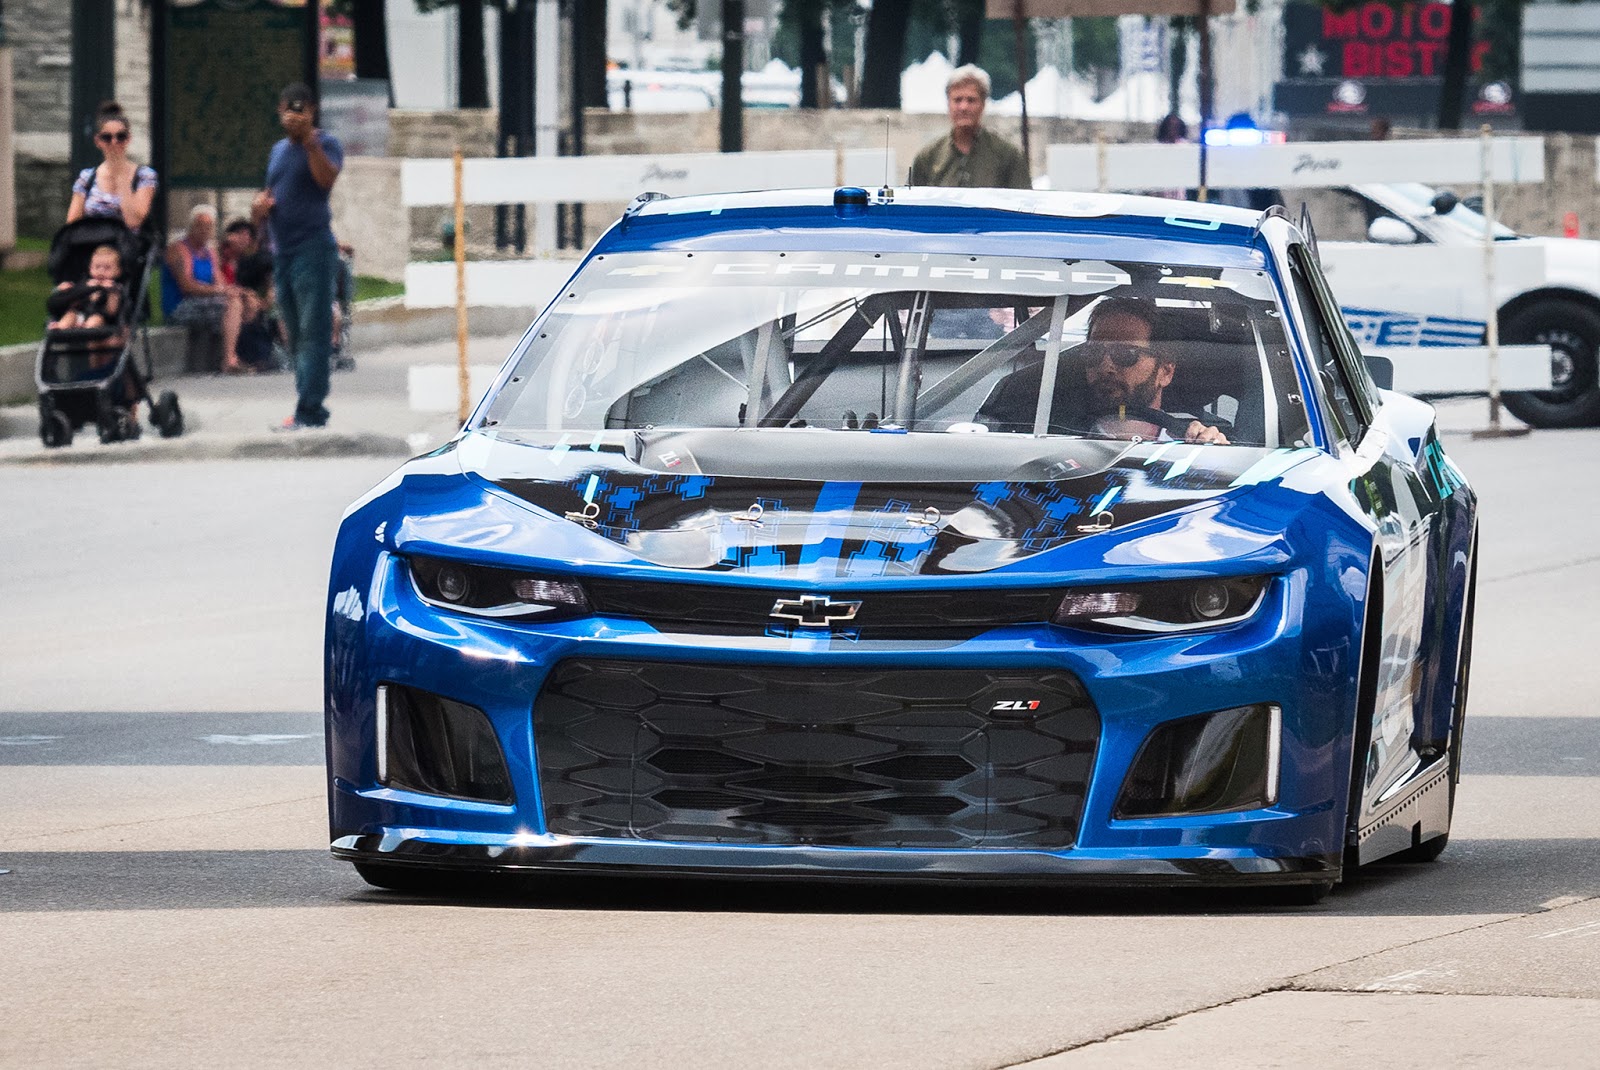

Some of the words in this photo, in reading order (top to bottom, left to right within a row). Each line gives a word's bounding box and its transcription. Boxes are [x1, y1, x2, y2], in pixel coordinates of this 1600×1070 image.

[1322, 2, 1481, 38] MOTO
[1343, 41, 1491, 77] BIST
[711, 262, 1133, 285] CAMARO
[992, 700, 1041, 711] ZL1
